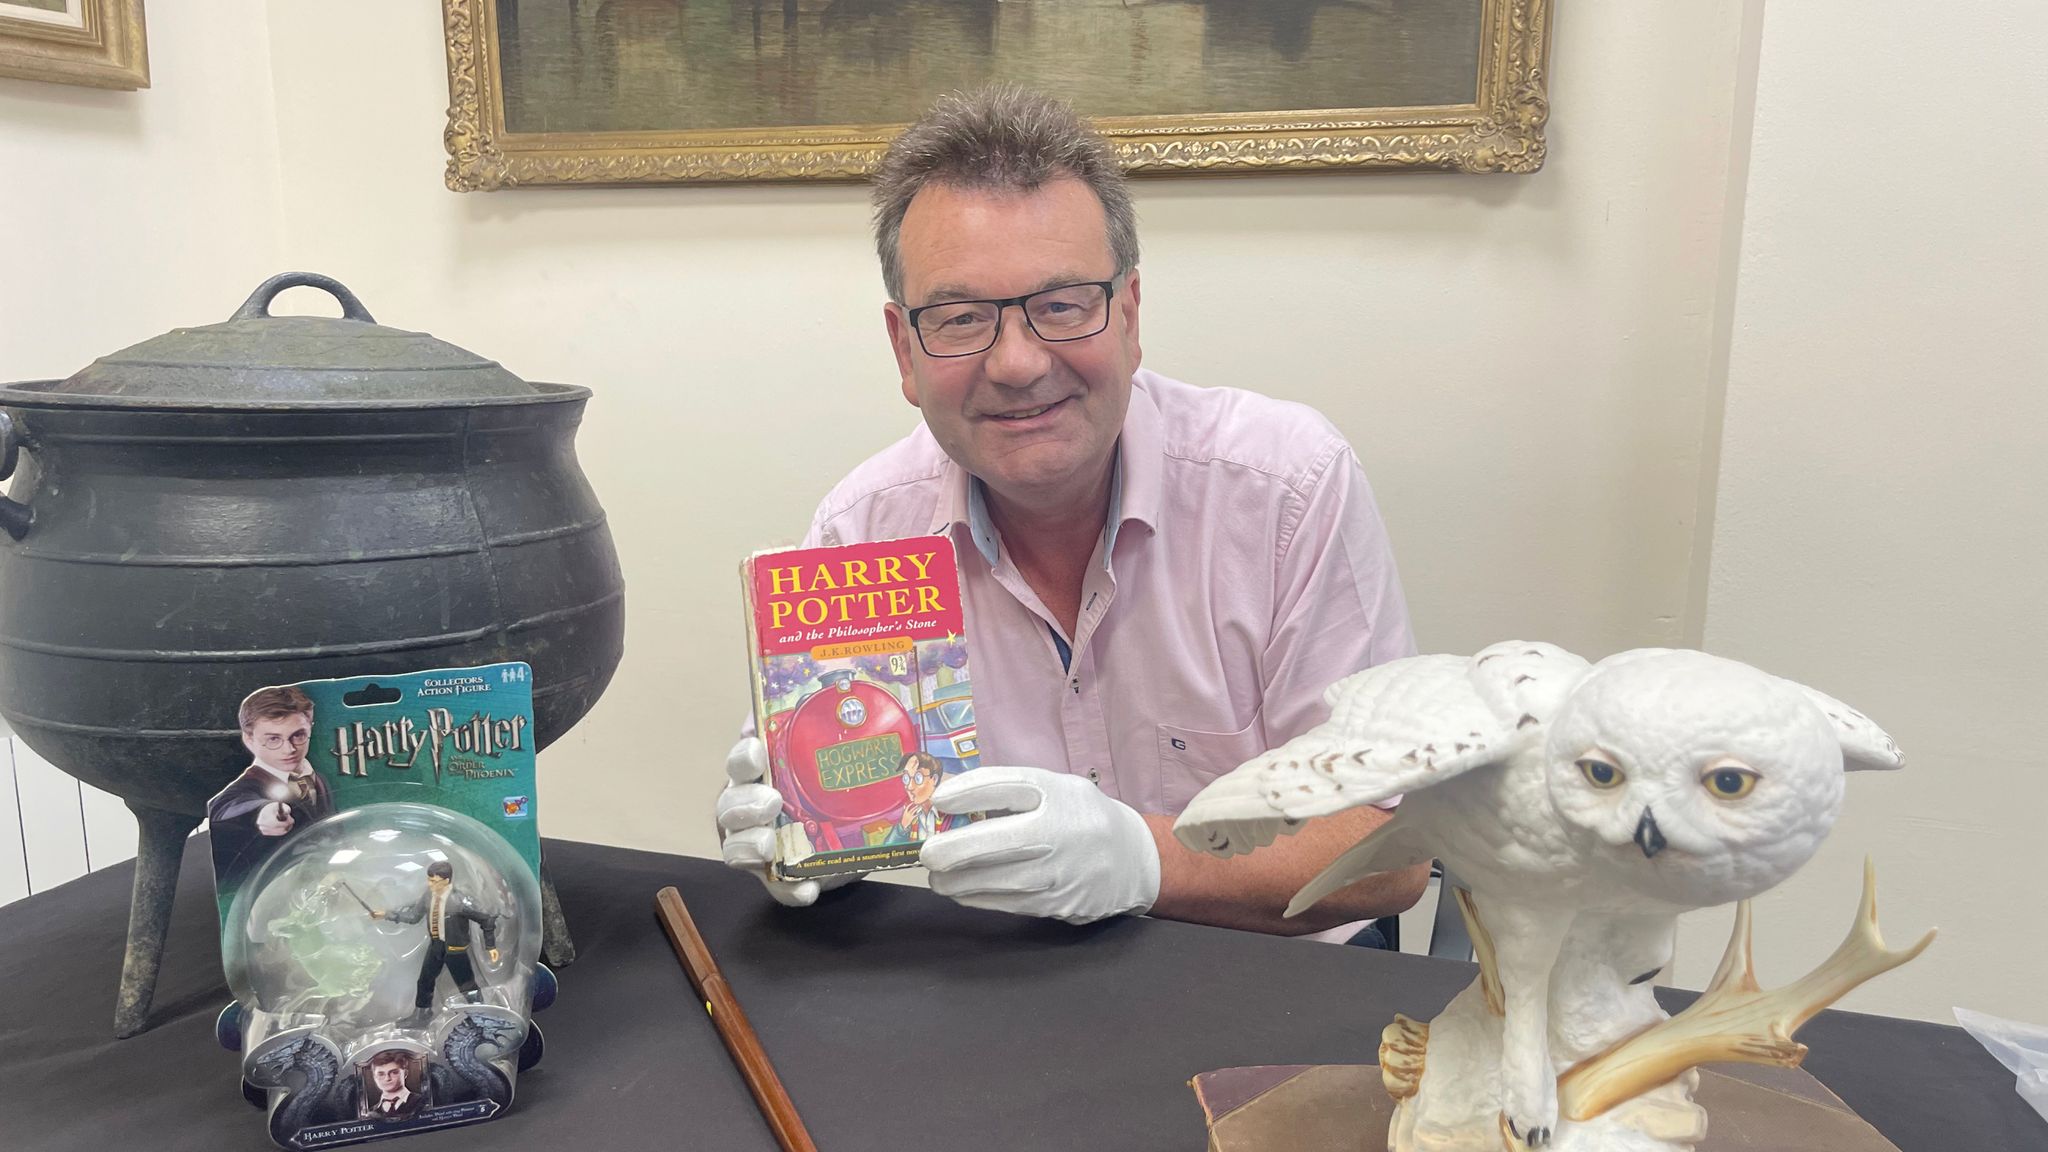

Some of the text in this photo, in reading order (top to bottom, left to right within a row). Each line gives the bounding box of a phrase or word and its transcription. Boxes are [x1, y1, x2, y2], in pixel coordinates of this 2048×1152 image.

[768, 552, 937, 595] HARRY
[768, 585, 946, 629] POTTER
[779, 618, 937, 644] and the Philosopher's Stone
[417, 684, 491, 697] ACTION FIGURE
[424, 676, 483, 687] COLLECTORS
[330, 707, 527, 784] Harry Potter
[448, 760, 485, 772] ORDER
[804, 858, 826, 868] terrific
[862, 852, 890, 860] stunning
[304, 1124, 374, 1142] HARRY POTTER
